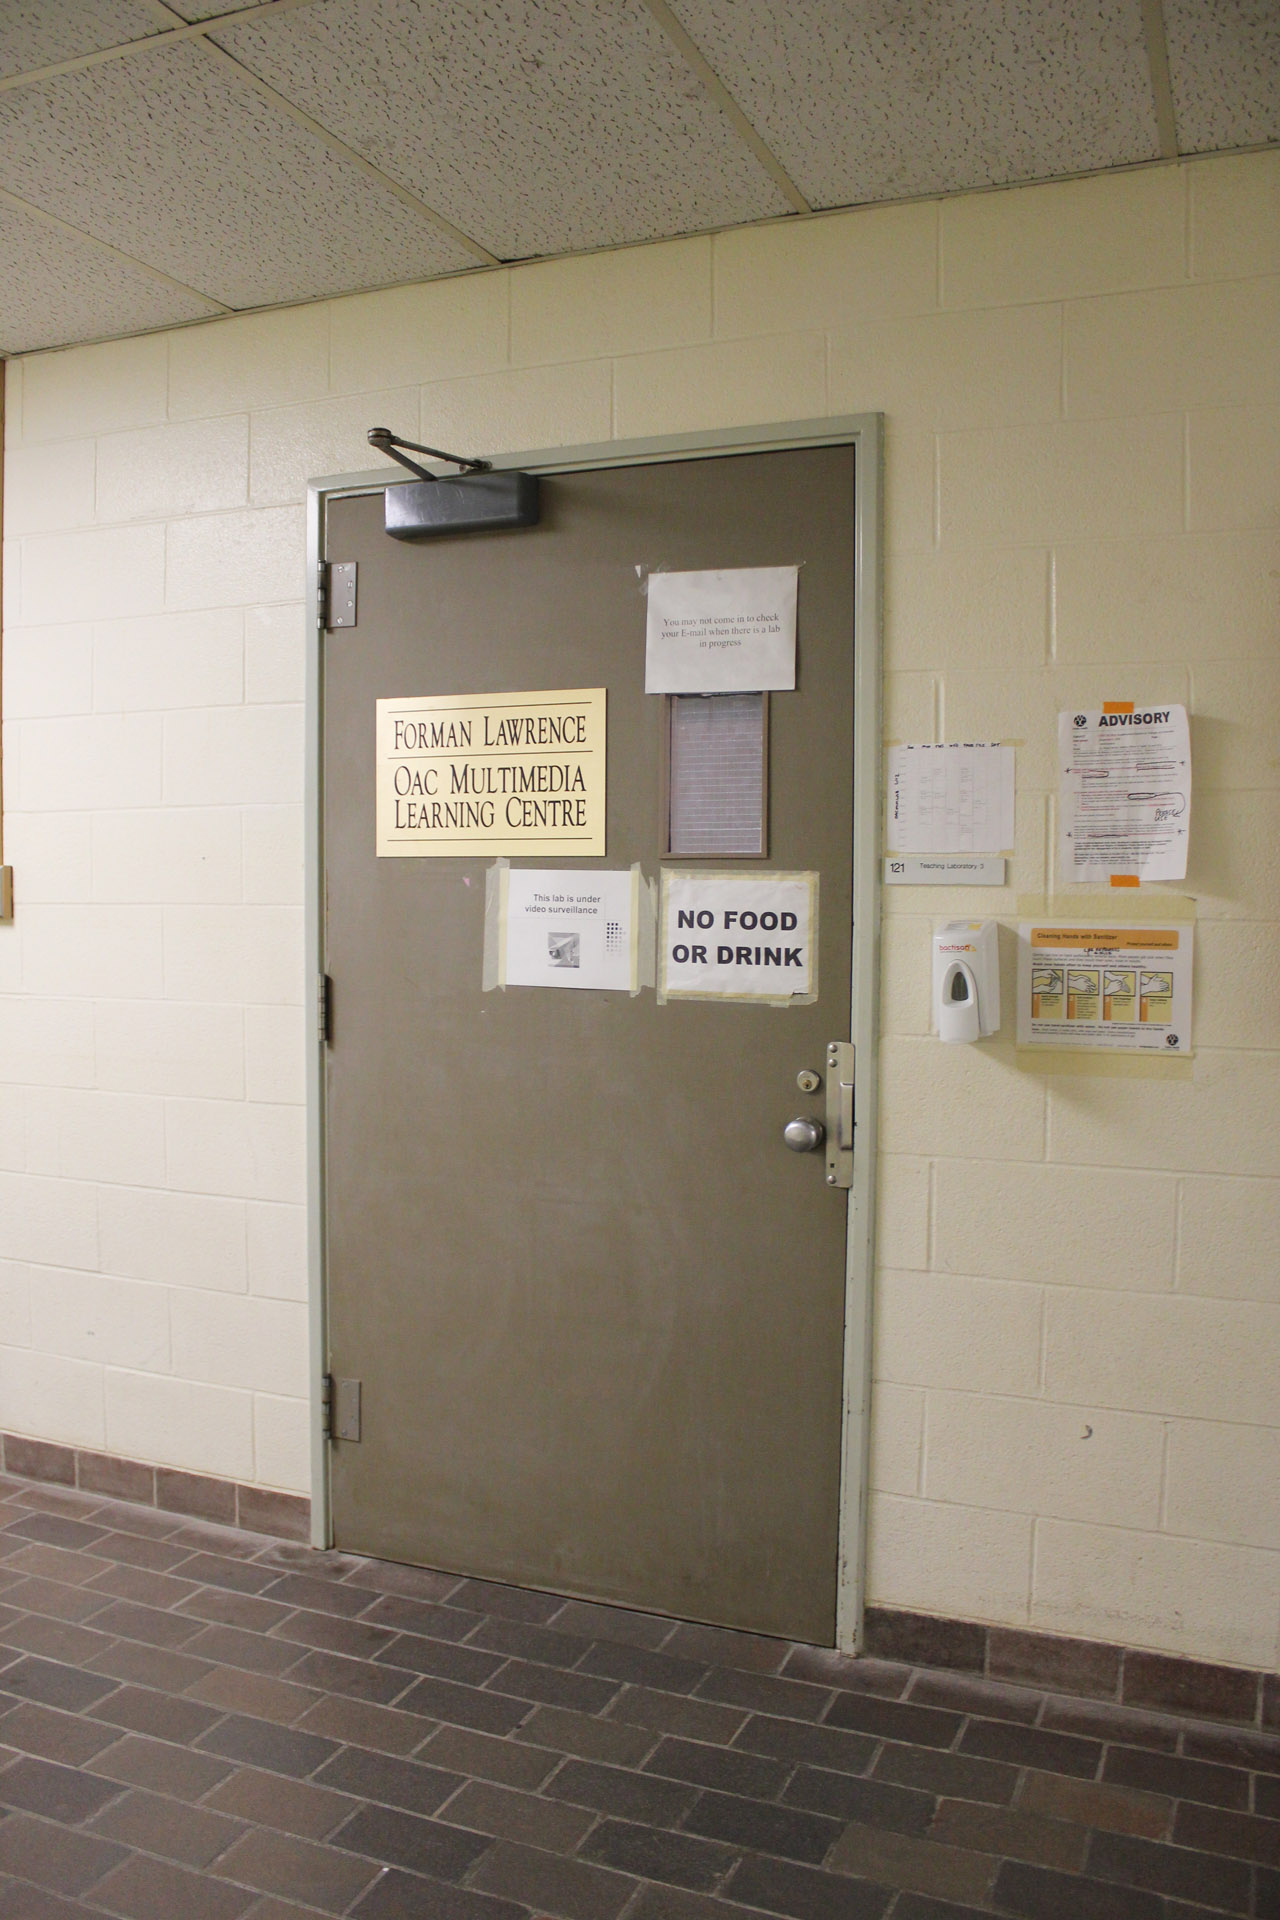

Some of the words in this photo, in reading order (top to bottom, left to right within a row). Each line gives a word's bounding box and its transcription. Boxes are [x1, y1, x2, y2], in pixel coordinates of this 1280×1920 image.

[663, 618, 679, 626] You
[682, 619, 697, 627] may
[756, 613, 779, 621] check
[661, 630, 679, 639] your
[681, 628, 706, 636] E-mail
[709, 627, 729, 636] when
[709, 639, 741, 648] progress
[1099, 712, 1170, 727] ADVISORY
[394, 720, 472, 750] FORMAN
[483, 716, 587, 746] LAWRENCE
[394, 766, 438, 796] OAC
[450, 764, 587, 794] MULTIMEDIA
[395, 800, 495, 829] LEARNING
[506, 796, 587, 827] CENTRE
[890, 863, 904, 873] 121
[552, 894, 564, 902] lab
[548, 906, 598, 914] surveillance
[678, 910, 714, 929] NO
[724, 911, 797, 931] FOOD
[672, 945, 707, 964] OR
[718, 946, 803, 967] DRINK
